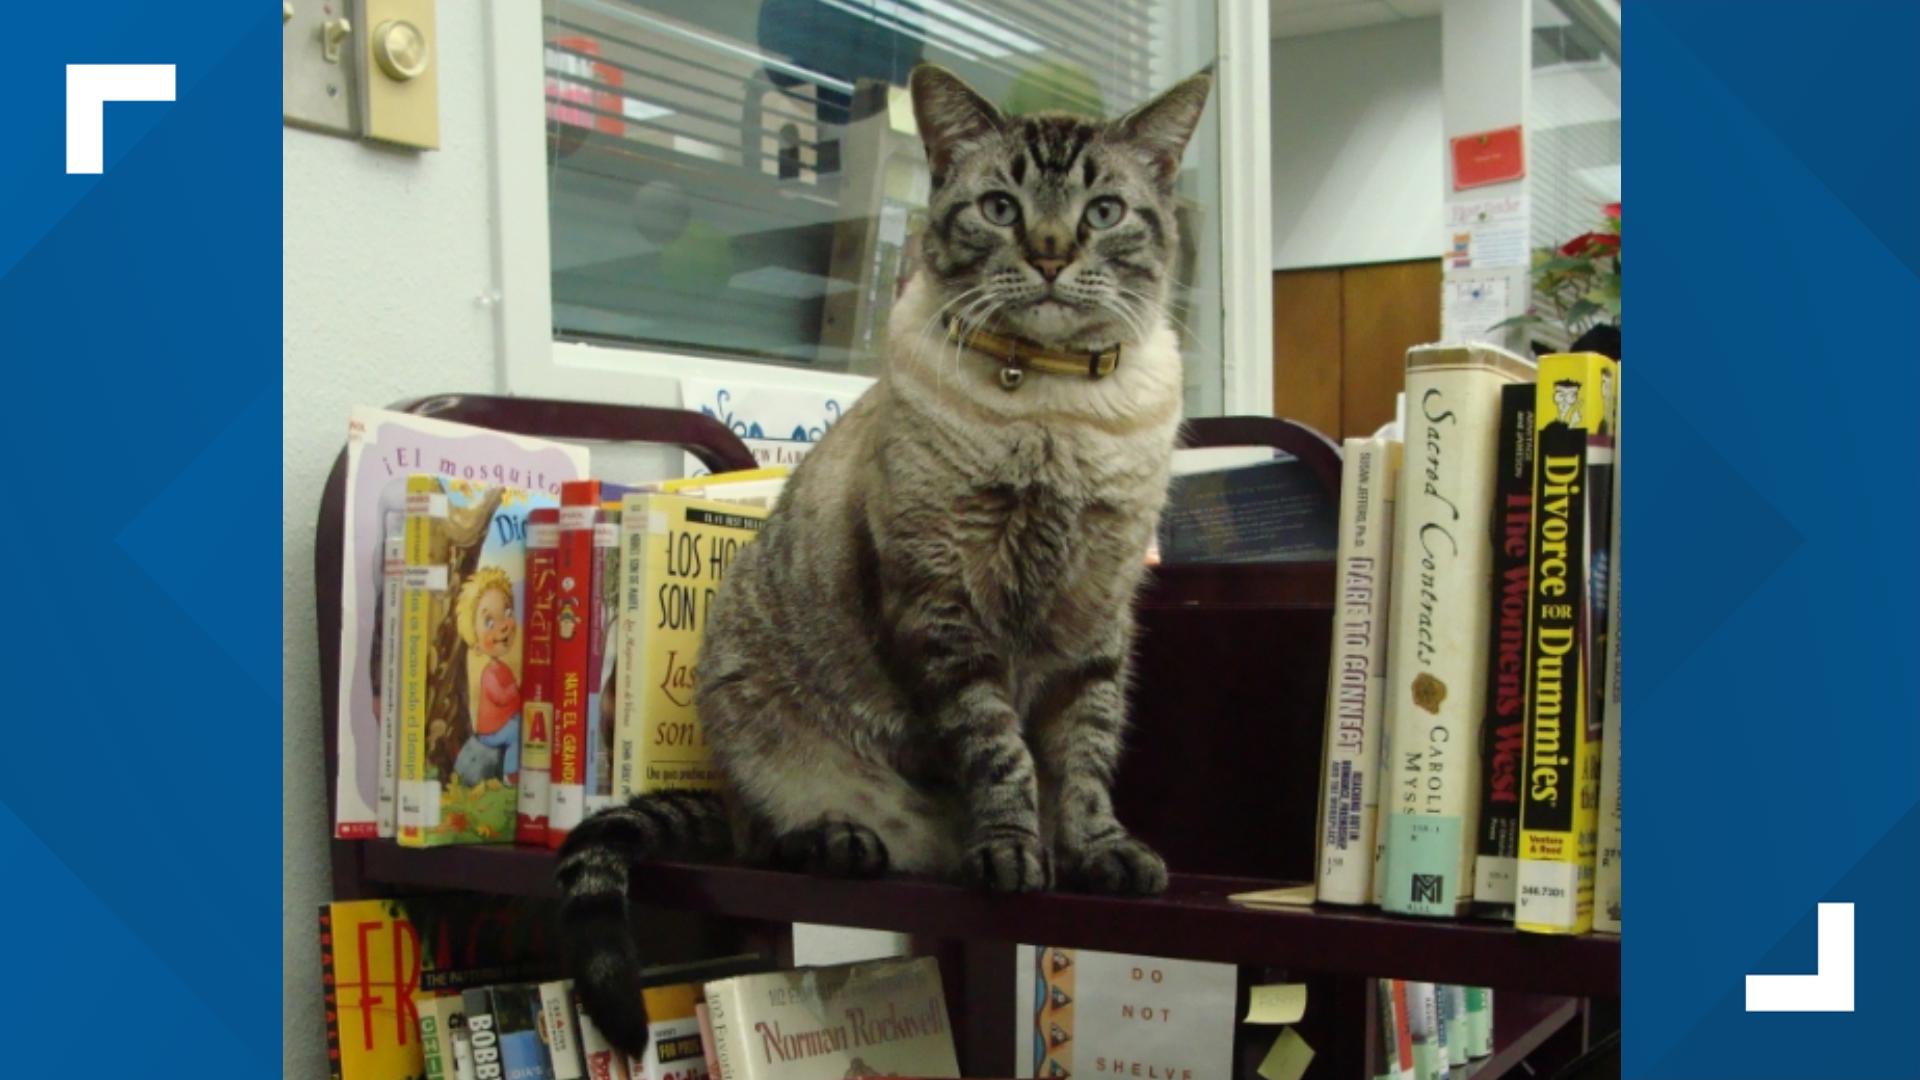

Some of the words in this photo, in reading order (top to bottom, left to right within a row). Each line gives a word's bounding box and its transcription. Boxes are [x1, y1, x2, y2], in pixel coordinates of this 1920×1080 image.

[1422, 387, 1460, 521] Sacred
[666, 530, 702, 578] LOS
[1504, 494, 1532, 557] The
[1538, 454, 1581, 598] Divorce
[658, 583, 696, 632] SON
[1346, 557, 1375, 614] DARE
[1416, 522, 1459, 666] Contracts
[1541, 604, 1572, 620] FOR
[1344, 620, 1371, 650] TO
[562, 672, 579, 707] NATE
[1337, 653, 1369, 756] CONNECT
[1532, 627, 1574, 804] Dummies
[562, 711, 578, 729] EL
[654, 721, 695, 747] son
[1425, 725, 1450, 815] CAROLI
[1490, 722, 1522, 801] West
[1131, 967, 1164, 984] DO
[754, 1019, 848, 1065] Norman
[845, 996, 945, 1048] Rockwell
[1122, 1004, 1171, 1022] NOT
[467, 1013, 501, 1080] BOBB
[1096, 1057, 1192, 1080] SHELVE
